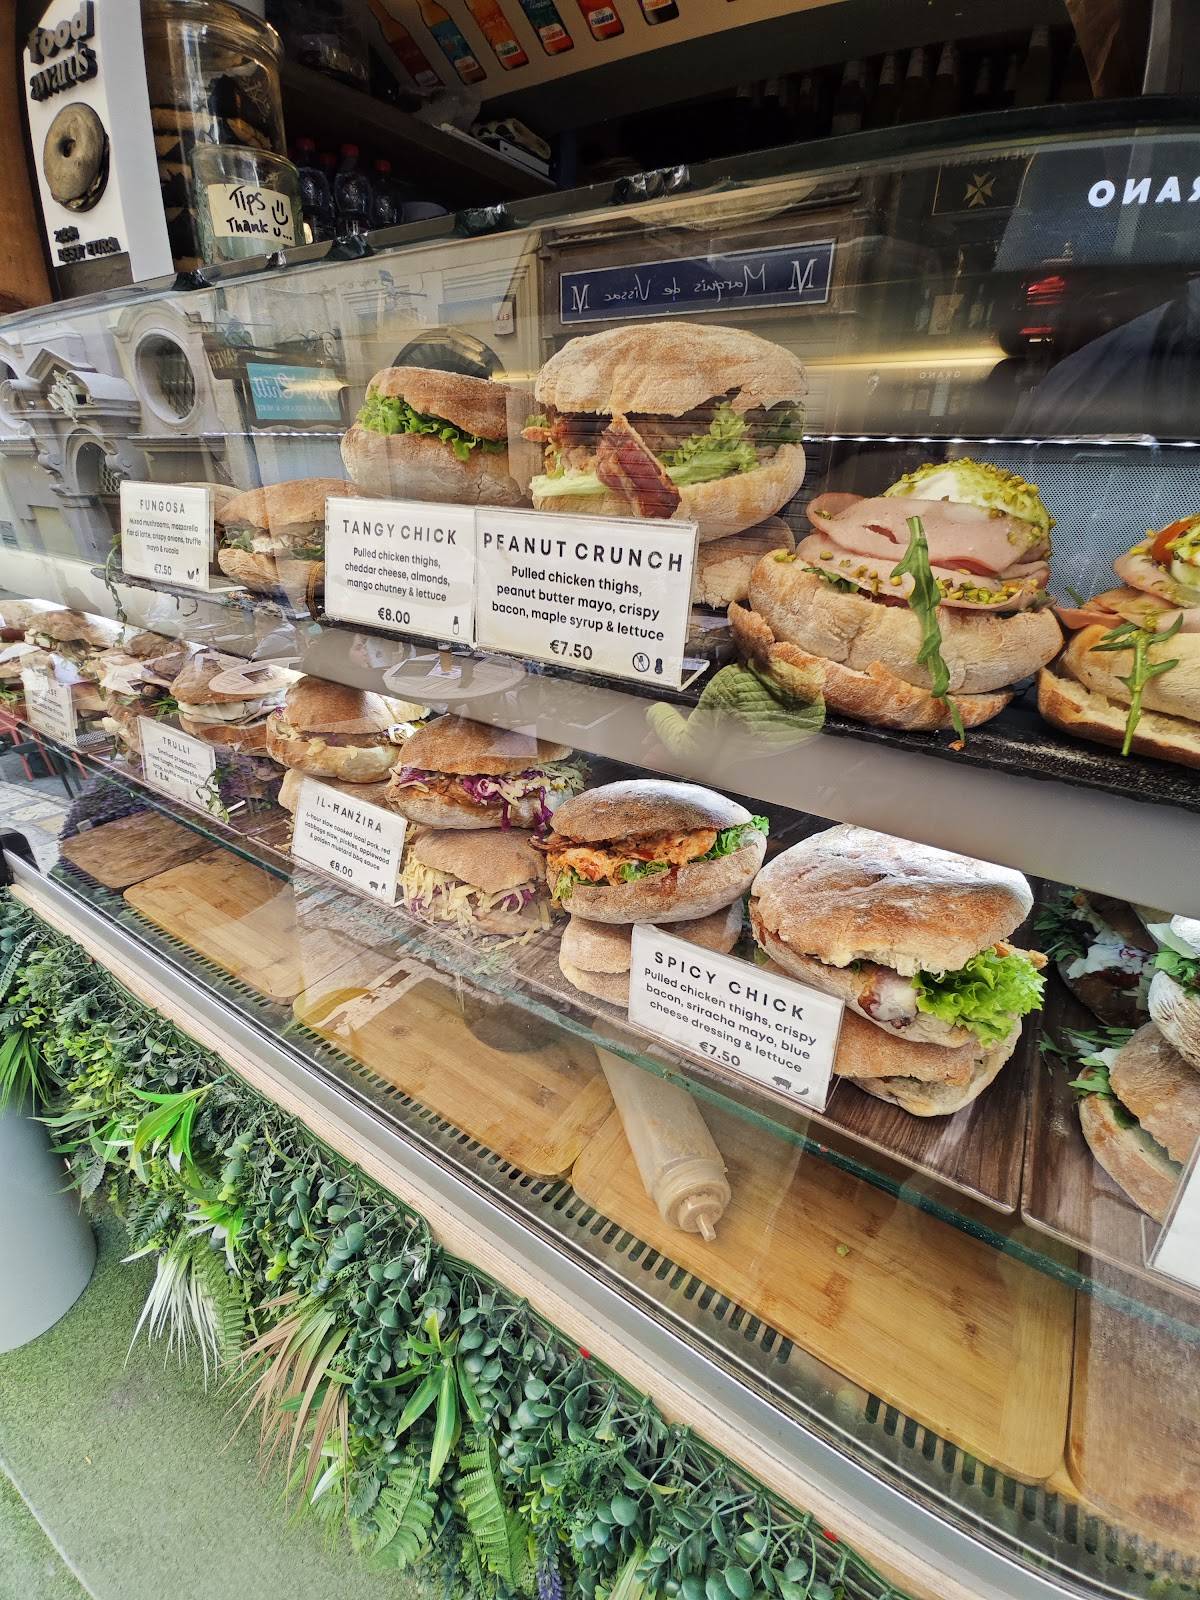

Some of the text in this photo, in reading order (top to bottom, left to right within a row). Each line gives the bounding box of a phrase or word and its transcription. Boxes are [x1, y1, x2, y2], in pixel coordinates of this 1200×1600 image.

[27, 0, 95, 64] food
[226, 217, 268, 233] Thank
[139, 499, 185, 514] FUNGOSA
[343, 519, 457, 545] TANGY CHICK
[154, 563, 172, 576] €7.50
[353, 547, 441, 569] Pulled chicken thighs,
[575, 542, 683, 573] CRUNCH
[345, 562, 450, 586] cheddar cheese, almonds,
[511, 565, 642, 597] Pulled chicken thighs,
[347, 578, 447, 602] mango chutney & lettuce
[497, 584, 660, 621] peanut butter mayo, crispy
[378, 607, 411, 625] €8.00
[492, 601, 664, 641] bacon, maple syrup & lettuce
[549, 639, 593, 661] €7.50
[162, 736, 190, 755] TRULLI
[305, 821, 326, 835] cabbage
[359, 847, 390, 865] applewood
[334, 825, 353, 838] cooked
[353, 833, 366, 844] local
[314, 835, 331, 847] golden
[331, 843, 352, 857] mustard
[353, 852, 363, 864] bbq
[364, 859, 380, 871] sauce
[329, 860, 353, 878] €8.00
[654, 951, 804, 1020] SPICY CHICK
[644, 967, 817, 1046] Pulled chicken thighs, crispy
[646, 983, 810, 1060] bacon, sriracha mayo, blue
[649, 999, 802, 1073] cheese dressing & lettuce
[699, 1041, 741, 1067] €7.50
